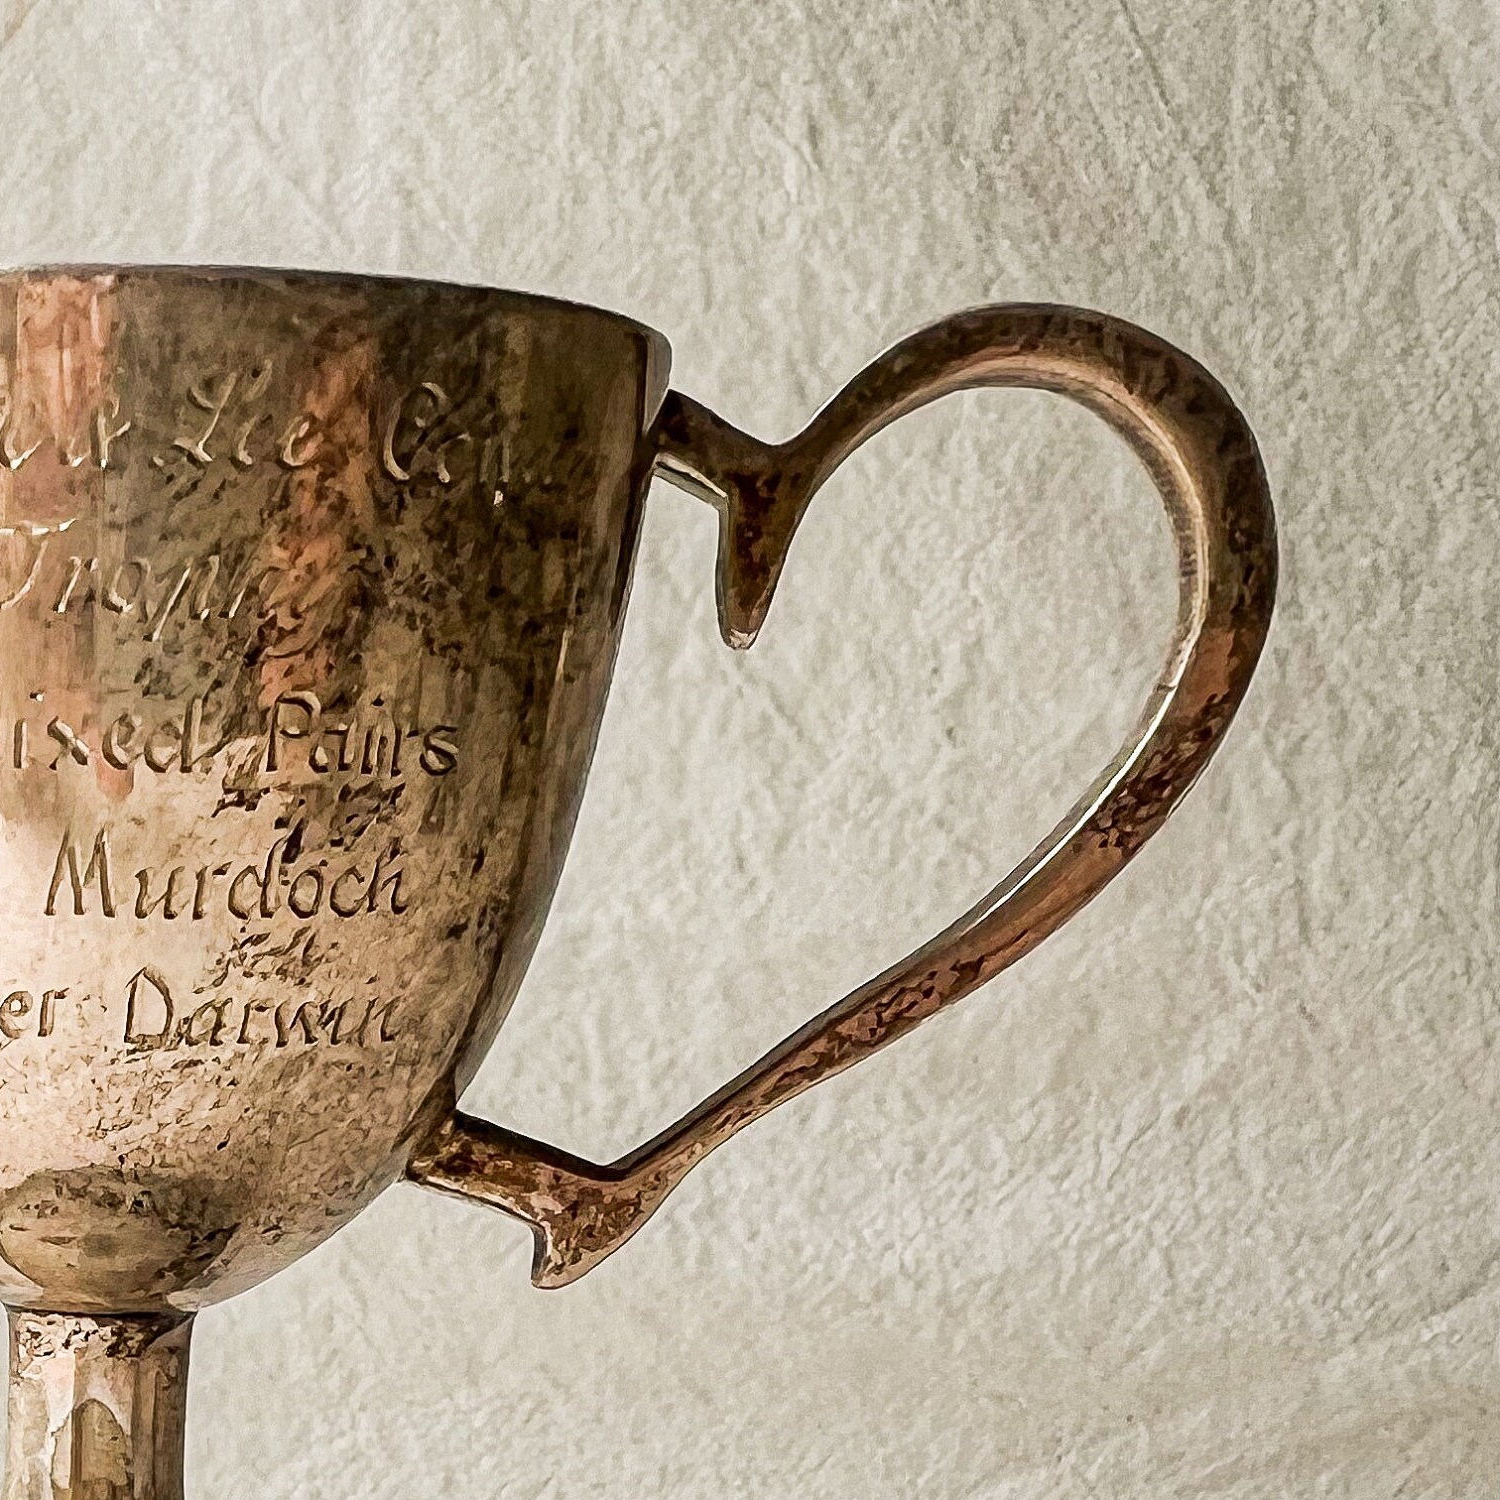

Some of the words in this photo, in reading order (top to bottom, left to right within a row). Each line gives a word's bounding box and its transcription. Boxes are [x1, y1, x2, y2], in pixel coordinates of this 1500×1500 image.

[263, 689, 459, 776] Pairs
[42, 824, 409, 920] Murdoch
[122, 964, 408, 1048] Darwin
